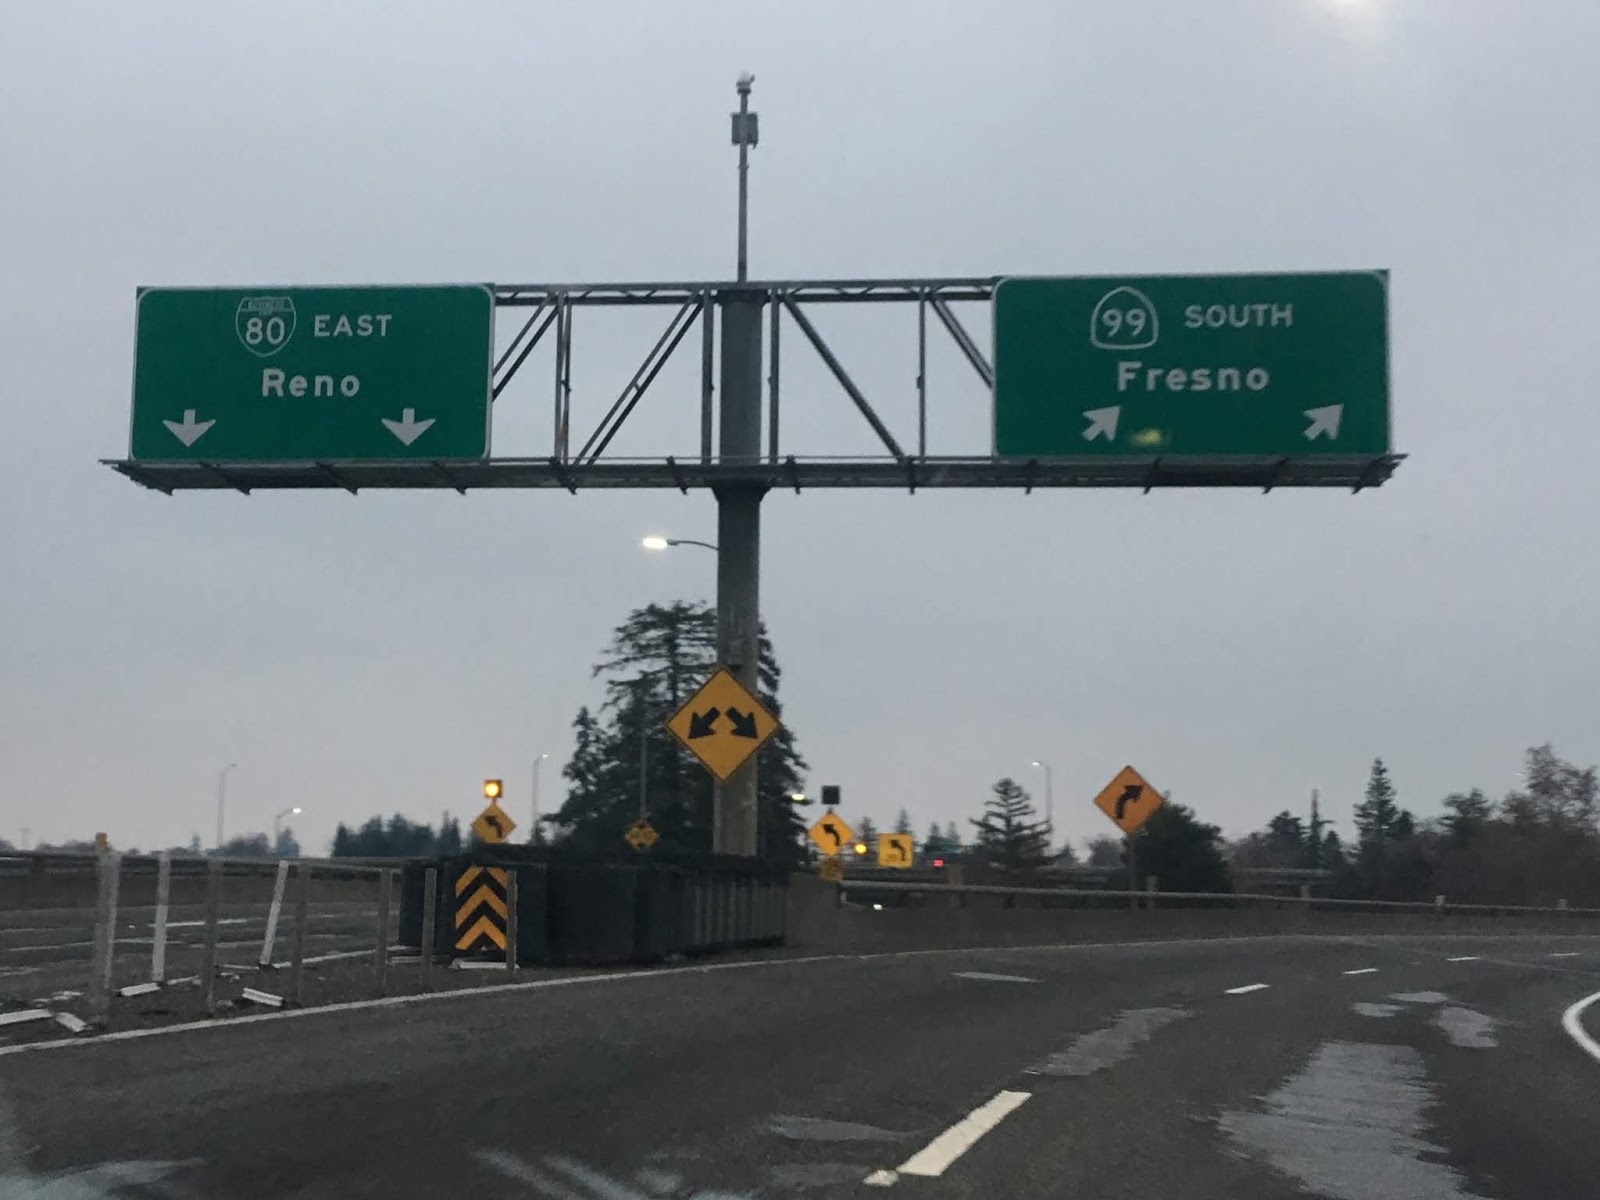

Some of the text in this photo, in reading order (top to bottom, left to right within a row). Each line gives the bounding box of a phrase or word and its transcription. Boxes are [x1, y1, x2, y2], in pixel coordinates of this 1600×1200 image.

[246, 314, 392, 344] 80 EAST
[1102, 303, 1293, 337] 99 SOUTH
[262, 367, 360, 397] Reno
[1117, 361, 1270, 392] Fresno
